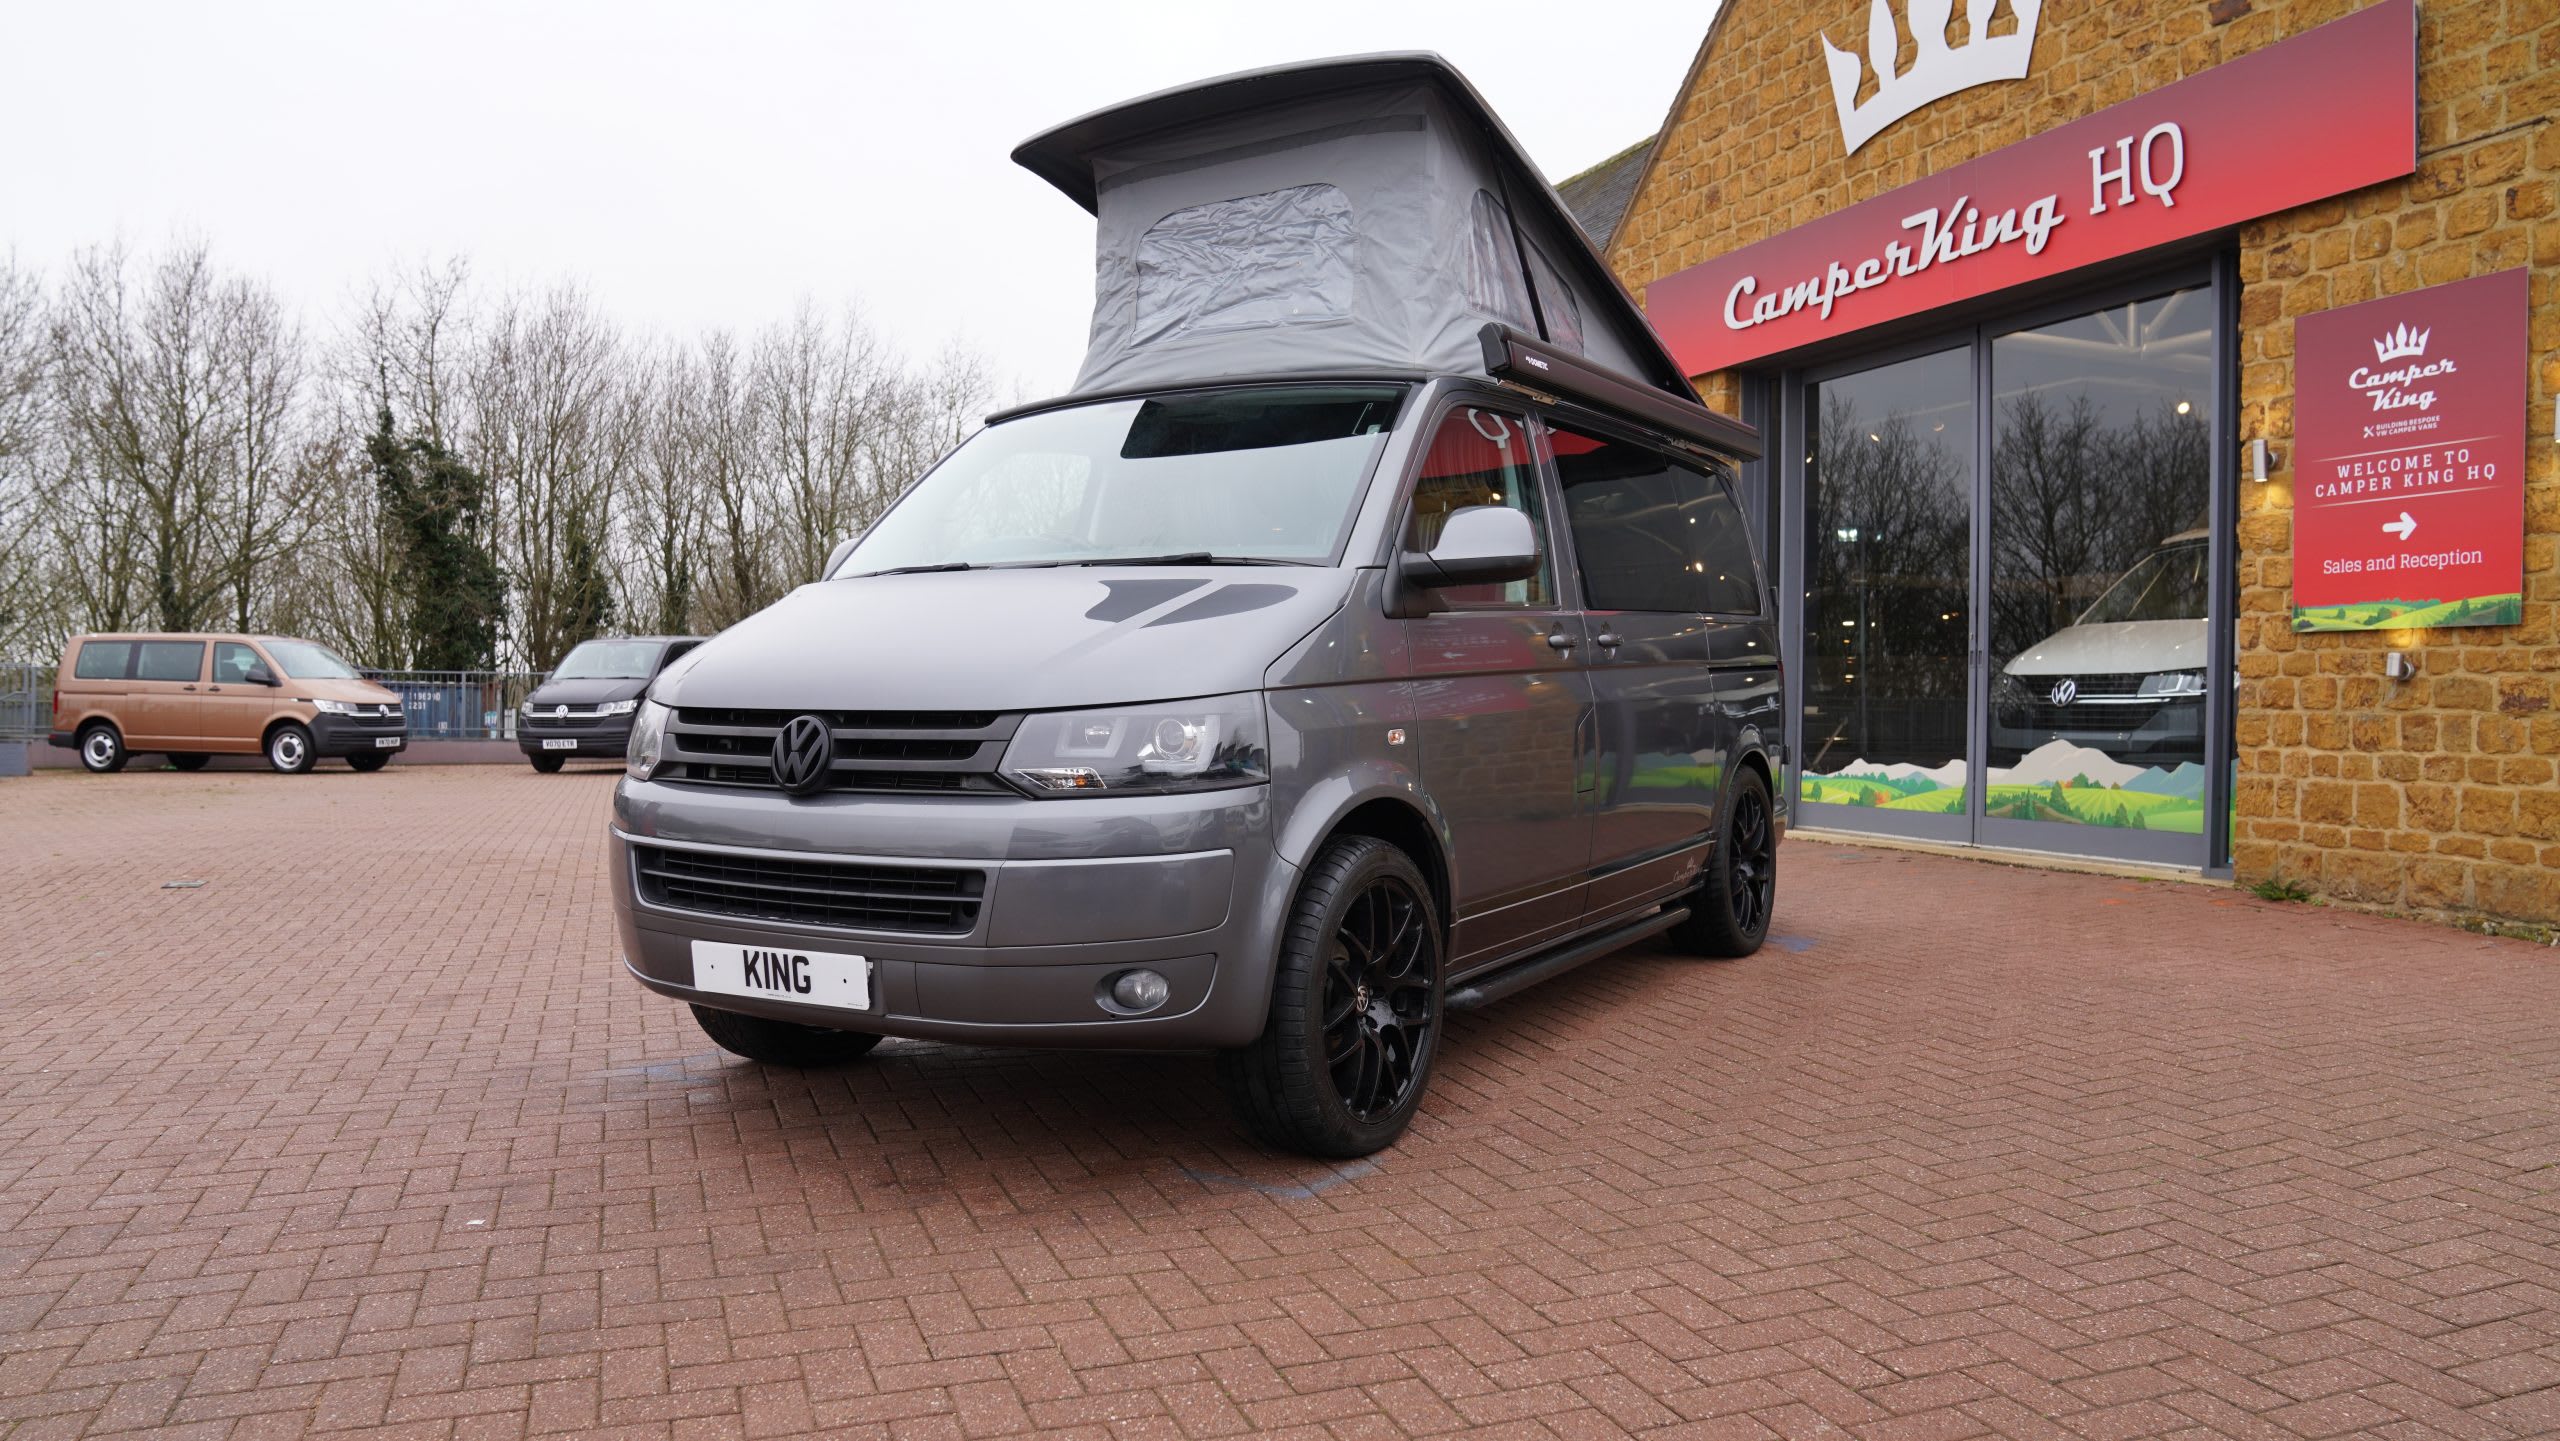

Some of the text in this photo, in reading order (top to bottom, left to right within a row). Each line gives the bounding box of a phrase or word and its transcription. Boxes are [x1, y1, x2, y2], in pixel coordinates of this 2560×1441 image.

[1723, 121, 2184, 330] CamperKing HQ
[2349, 358, 2457, 389] Camper
[2366, 386, 2437, 412] King
[2376, 415, 2441, 431] BUILDING BESPOKE
[2376, 422, 2438, 437] VW CAMPER VANS
[2337, 448, 2469, 479] WELCOME TO
[2315, 463, 2496, 498] CAMPER KING HQ
[2323, 549, 2483, 575] Sales and Reception
[743, 949, 811, 994] KING
